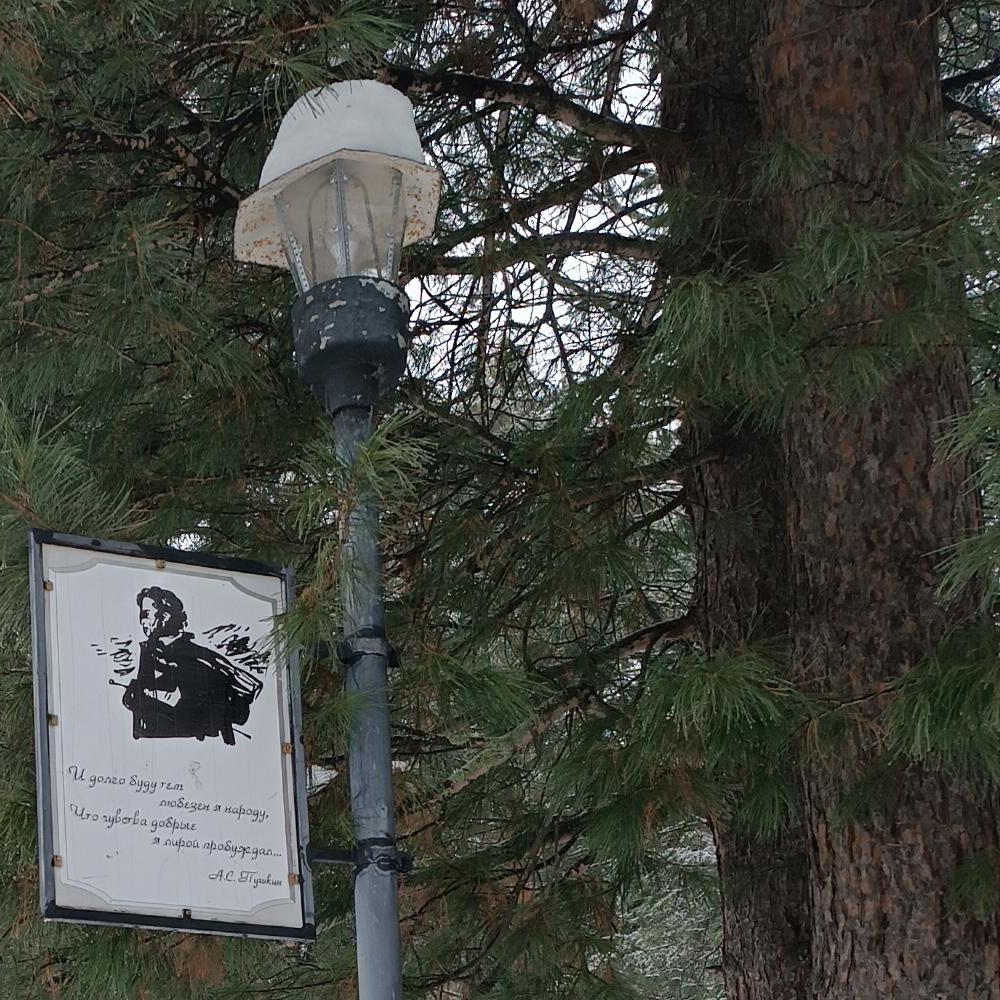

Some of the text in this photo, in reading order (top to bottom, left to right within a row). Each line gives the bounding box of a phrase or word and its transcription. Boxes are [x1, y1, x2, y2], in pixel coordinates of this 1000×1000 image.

[68, 766, 184, 794] И долго буду тем
[70, 804, 197, 834] Что чувства добрые
[160, 797, 269, 823] любезен я народу,
[152, 837, 282, 860] я лирой пробуждал...
[238, 871, 282, 888] Пушкин
